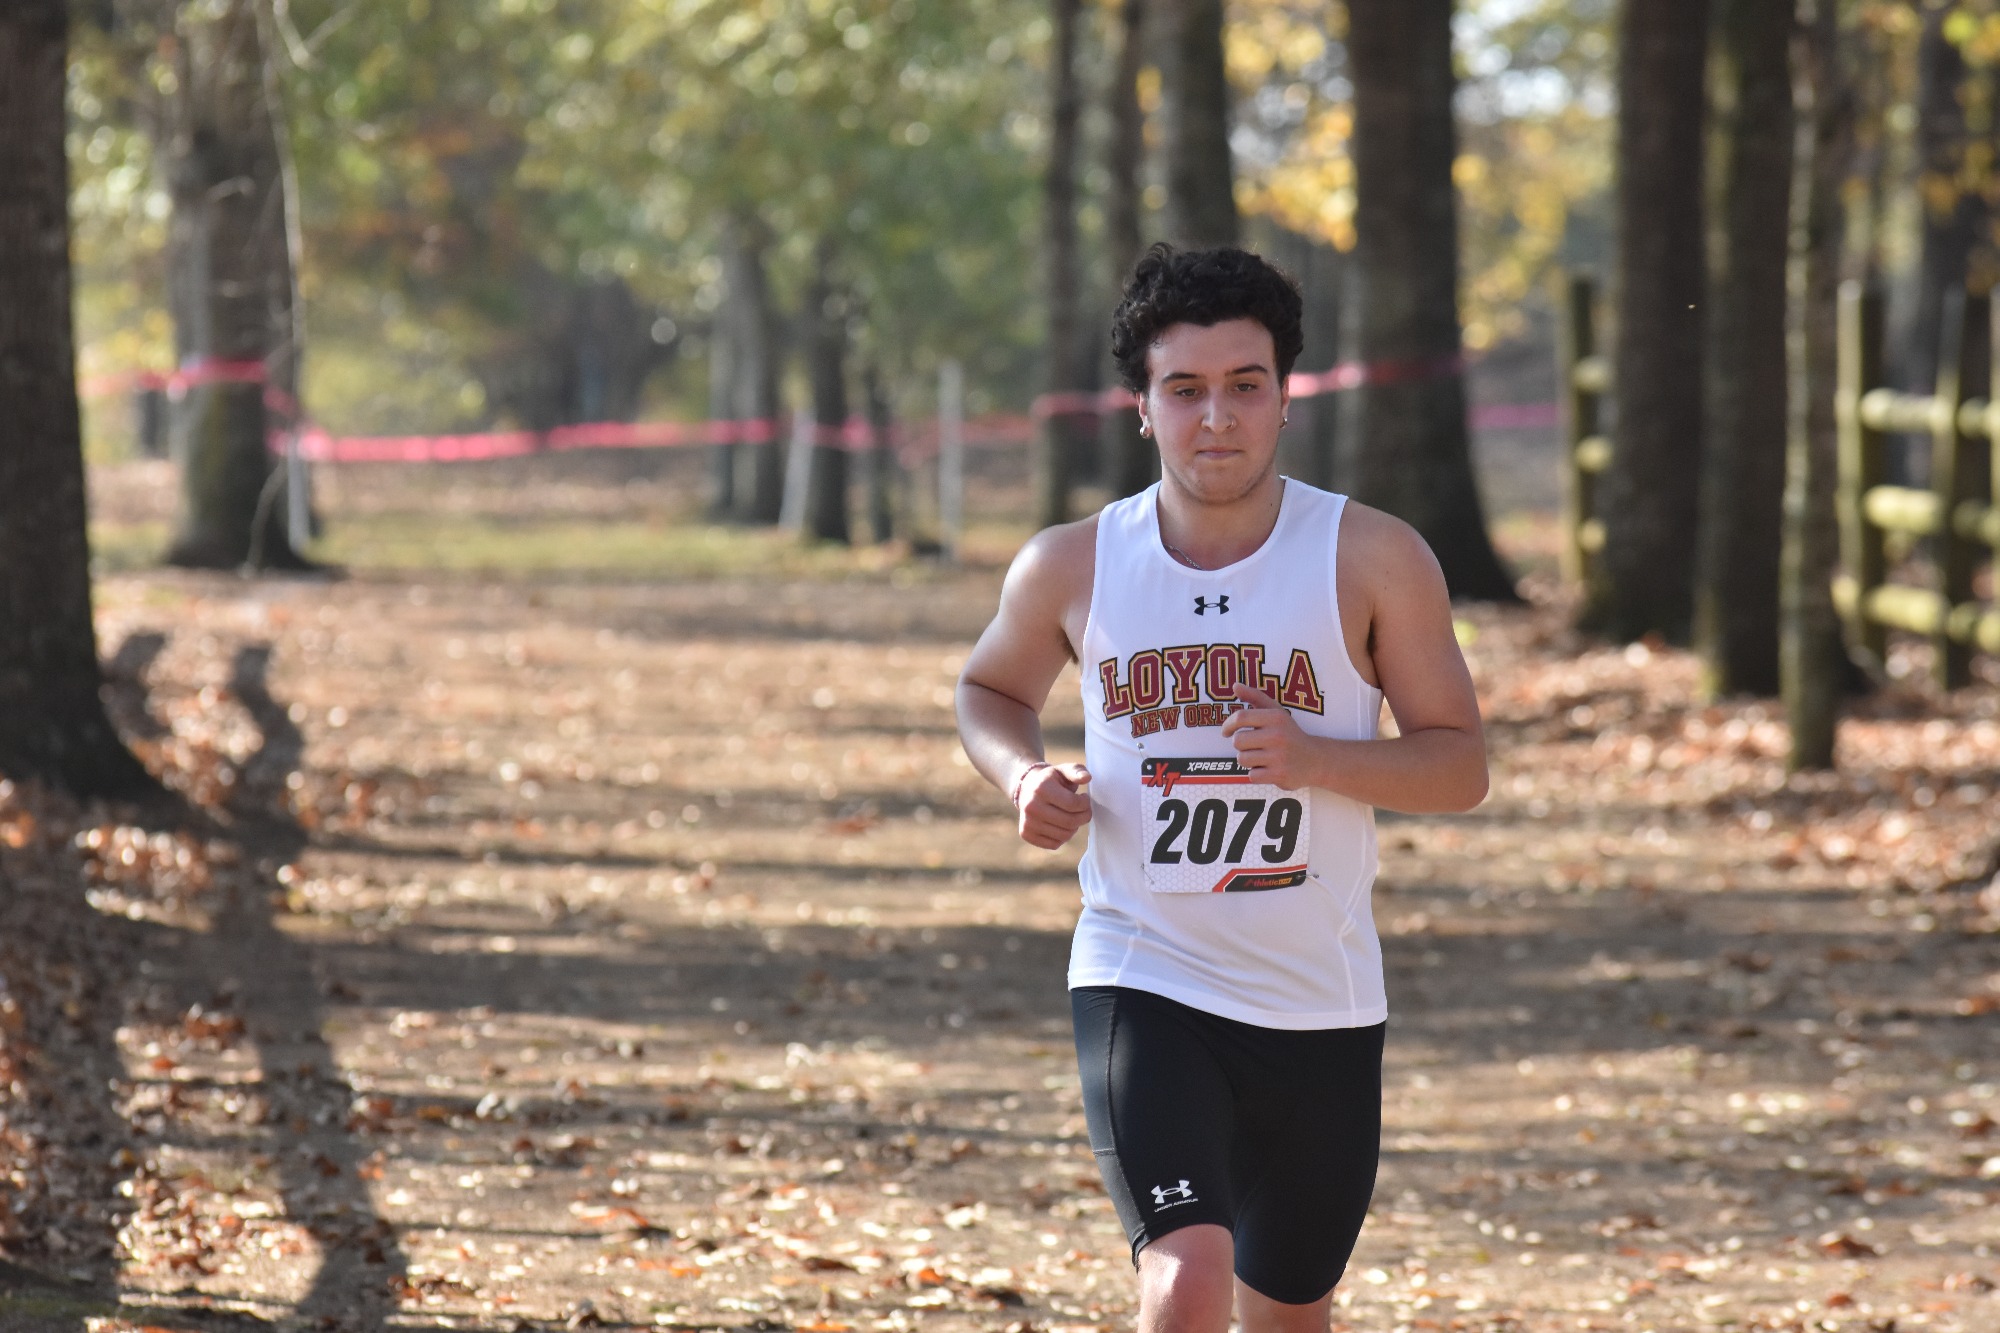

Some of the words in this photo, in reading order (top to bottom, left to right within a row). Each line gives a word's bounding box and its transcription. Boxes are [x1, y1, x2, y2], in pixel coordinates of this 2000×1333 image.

[1099, 643, 1324, 722] LOYOLA
[1131, 706, 1181, 738] NEW
[1187, 761, 1233, 772] XPRESS
[1150, 798, 1303, 865] 2079
